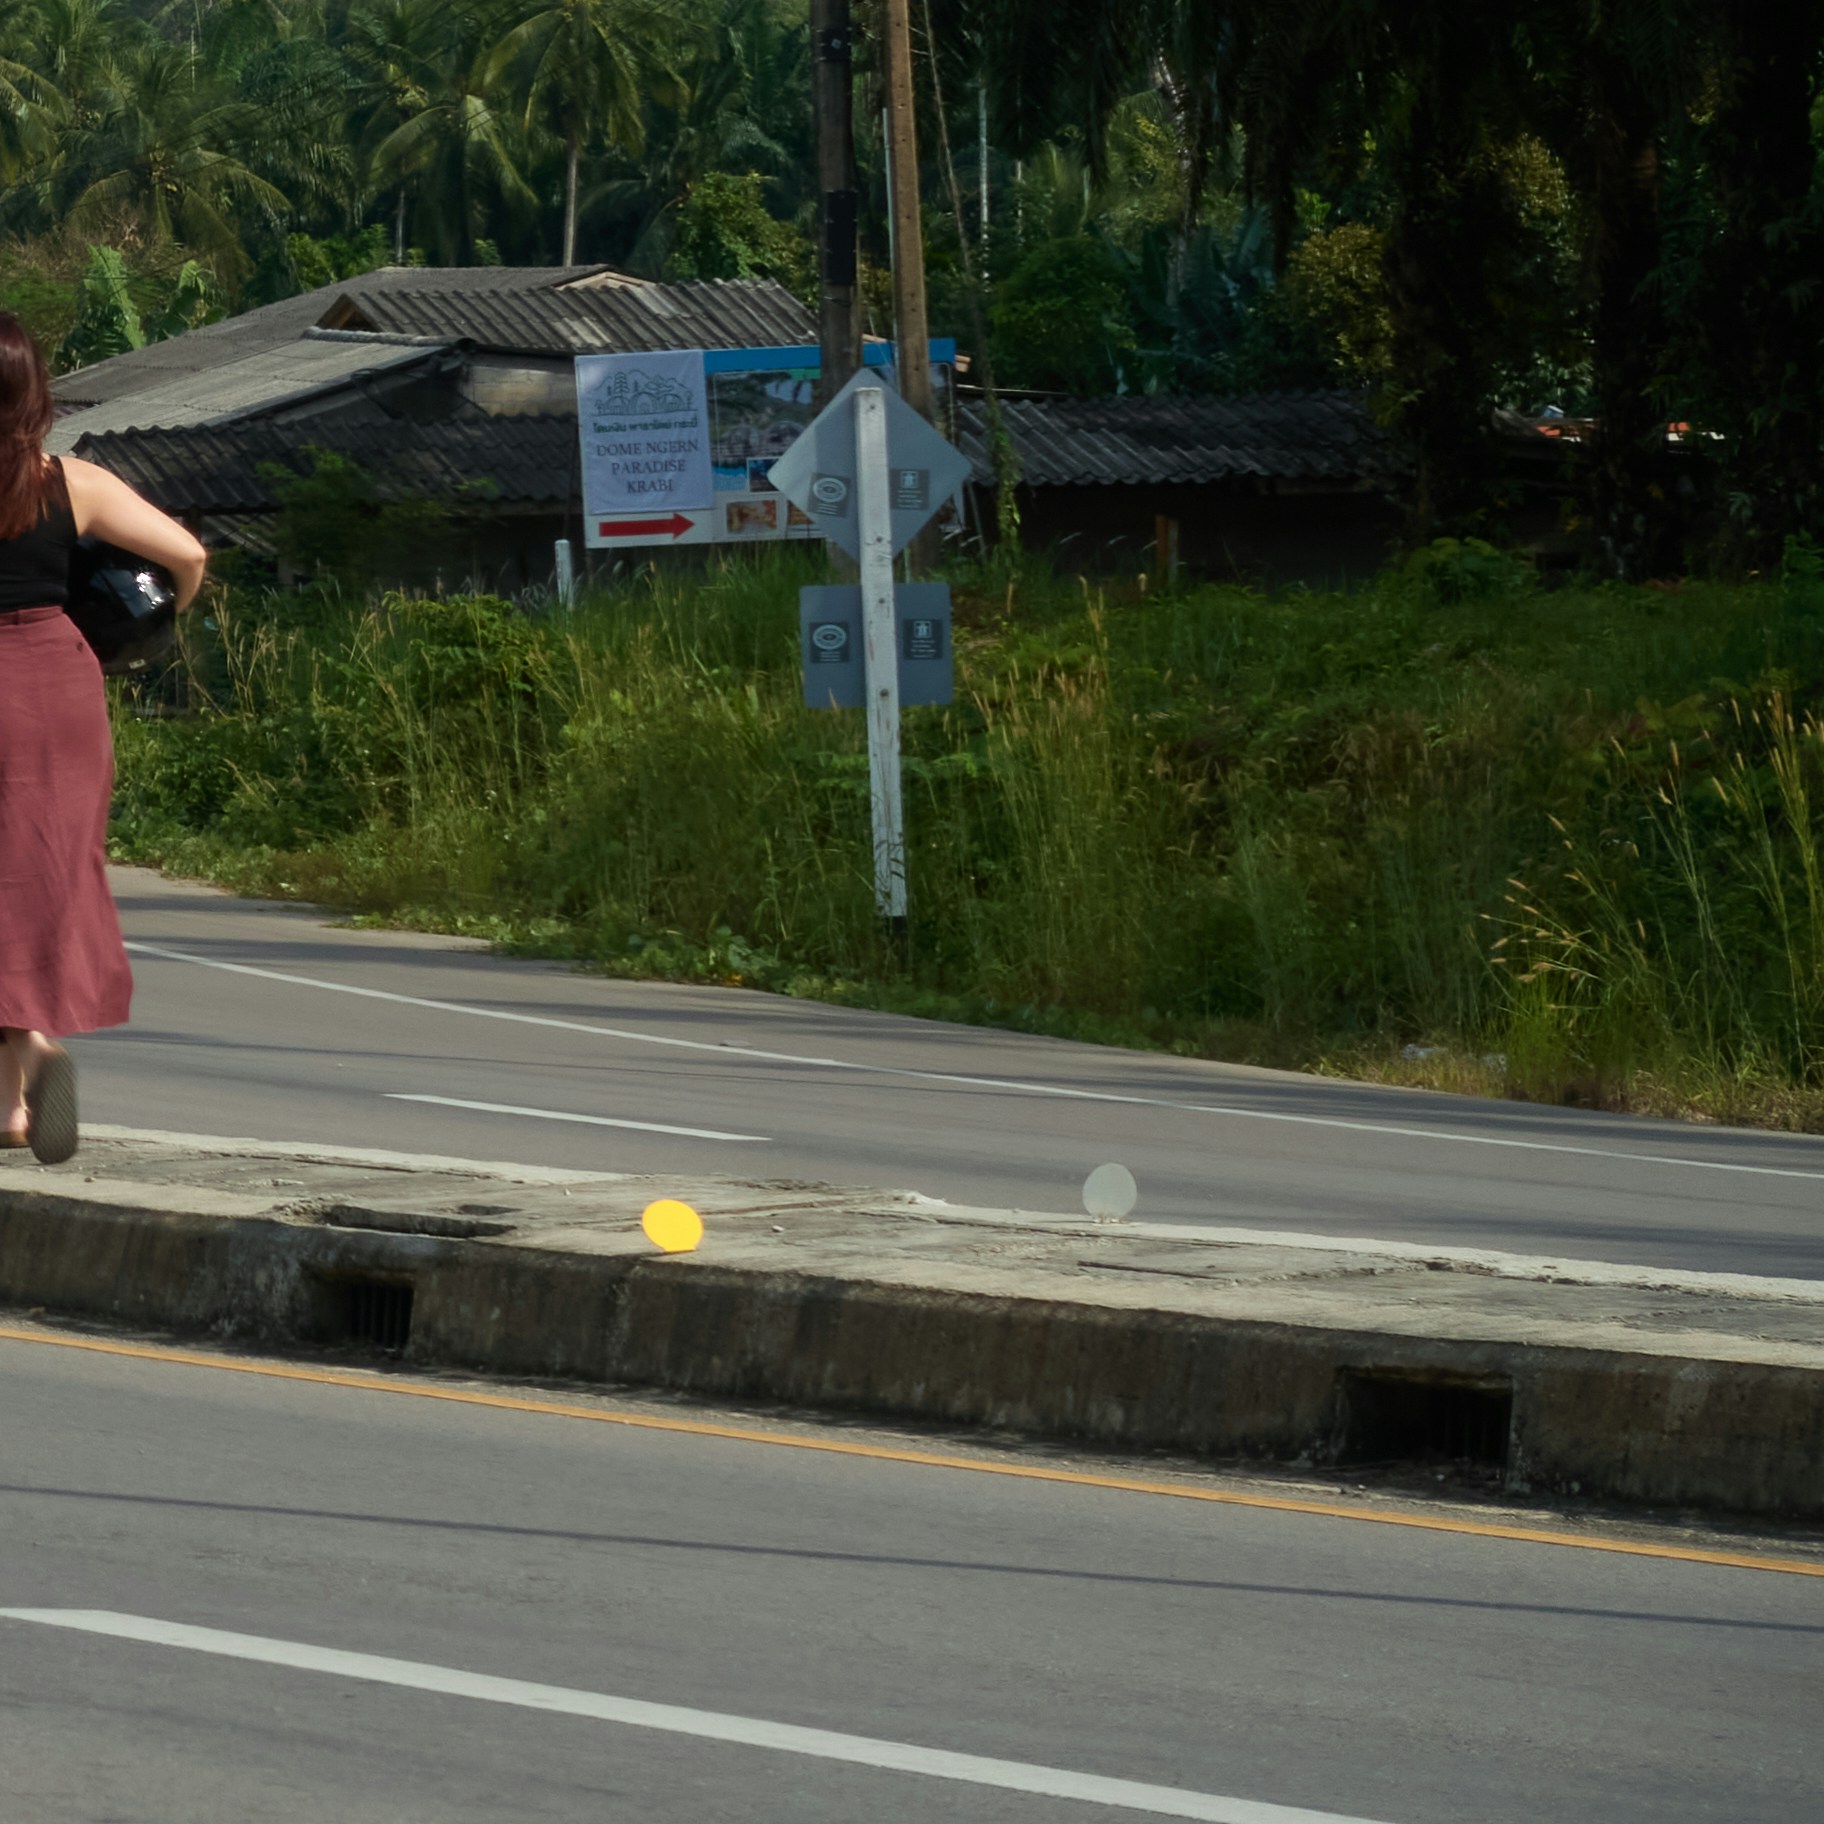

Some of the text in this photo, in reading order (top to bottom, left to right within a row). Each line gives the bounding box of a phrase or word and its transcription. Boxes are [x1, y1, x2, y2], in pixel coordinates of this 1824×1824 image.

[597, 440, 698, 456] DOME NGERN
[612, 460, 686, 475] PARADISE
[627, 479, 673, 493] KRABI
